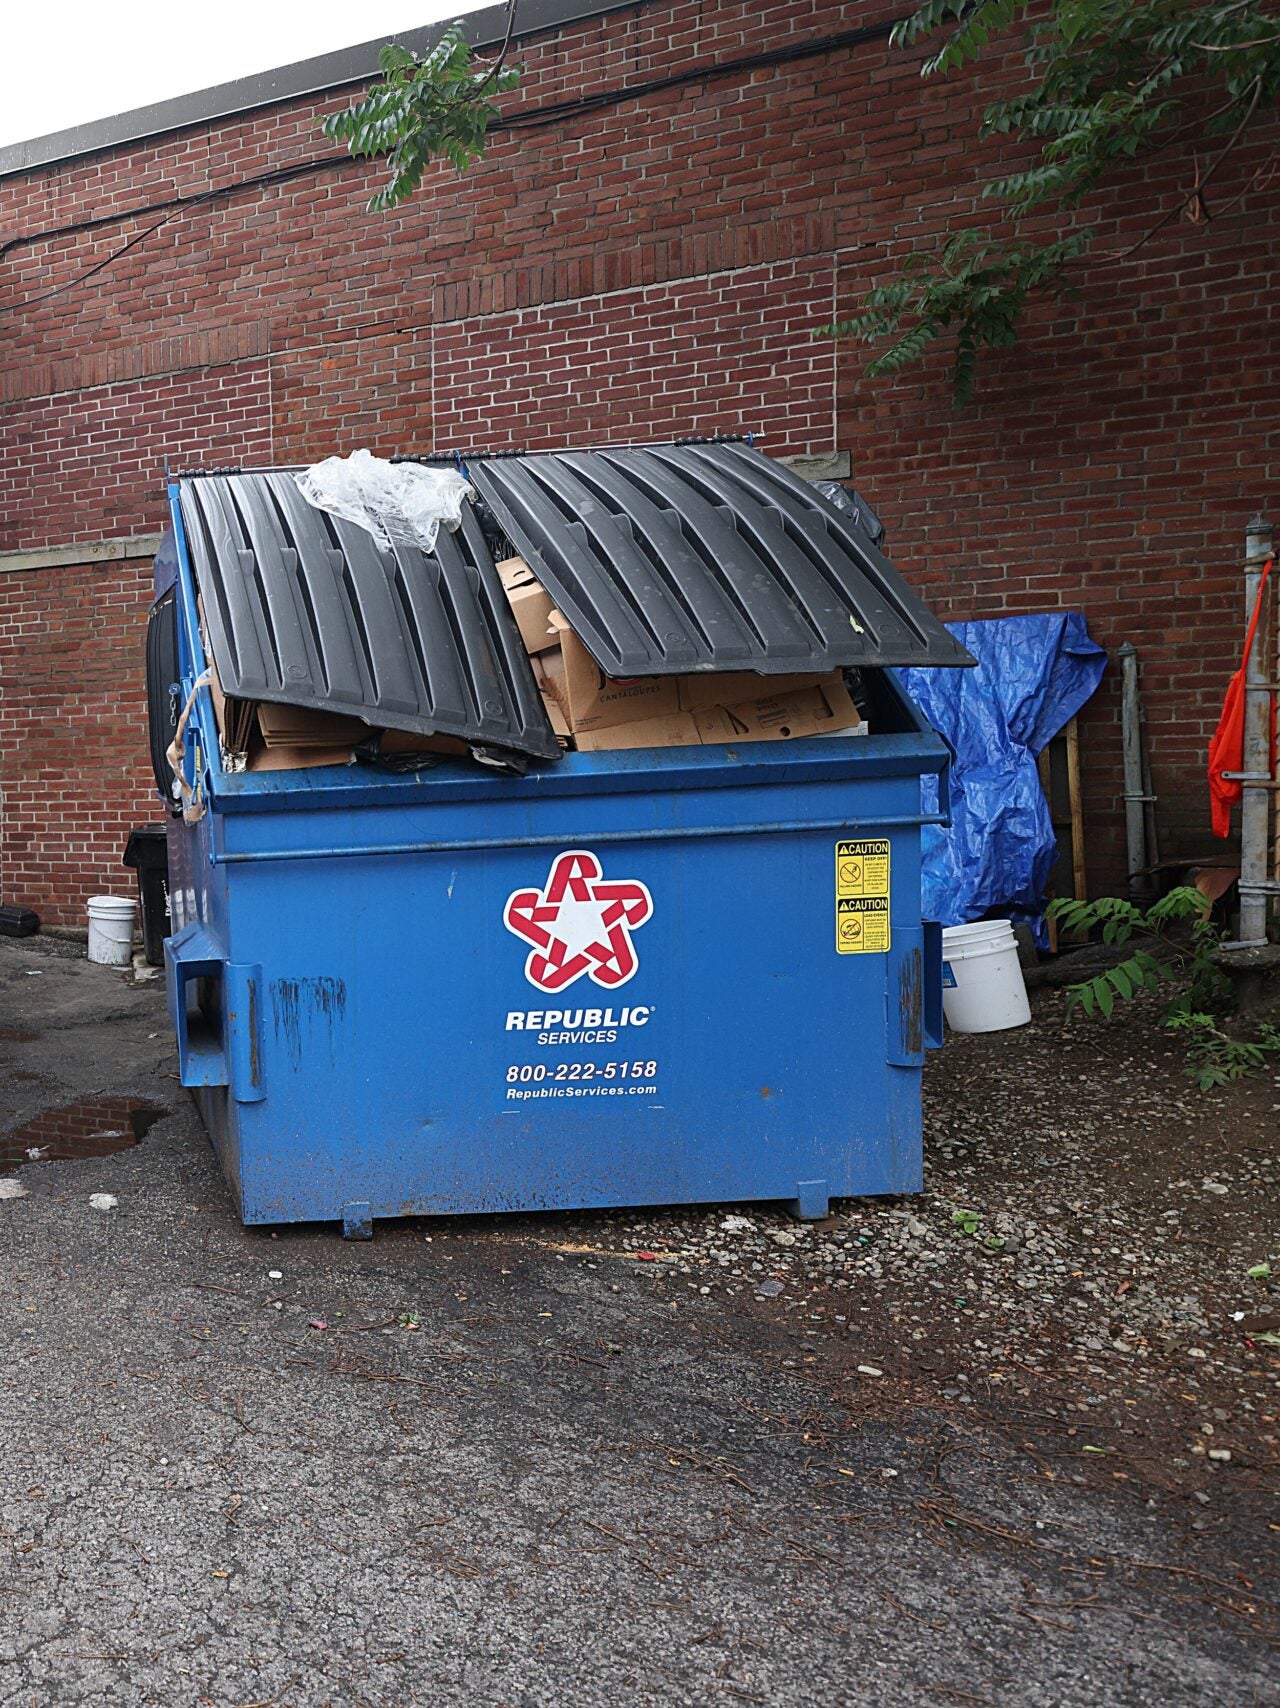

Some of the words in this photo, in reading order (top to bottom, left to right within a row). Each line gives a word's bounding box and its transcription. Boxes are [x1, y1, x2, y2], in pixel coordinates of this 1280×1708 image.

[599, 685, 661, 702] CANTALOUPES
[849, 843, 887, 854] CAUTION
[849, 899, 887, 911] CAUTION
[537, 1030, 617, 1045] SERVICES
[506, 1061, 657, 1083] 800-222-5158
[506, 1086, 657, 1100] RepublicServices.com
